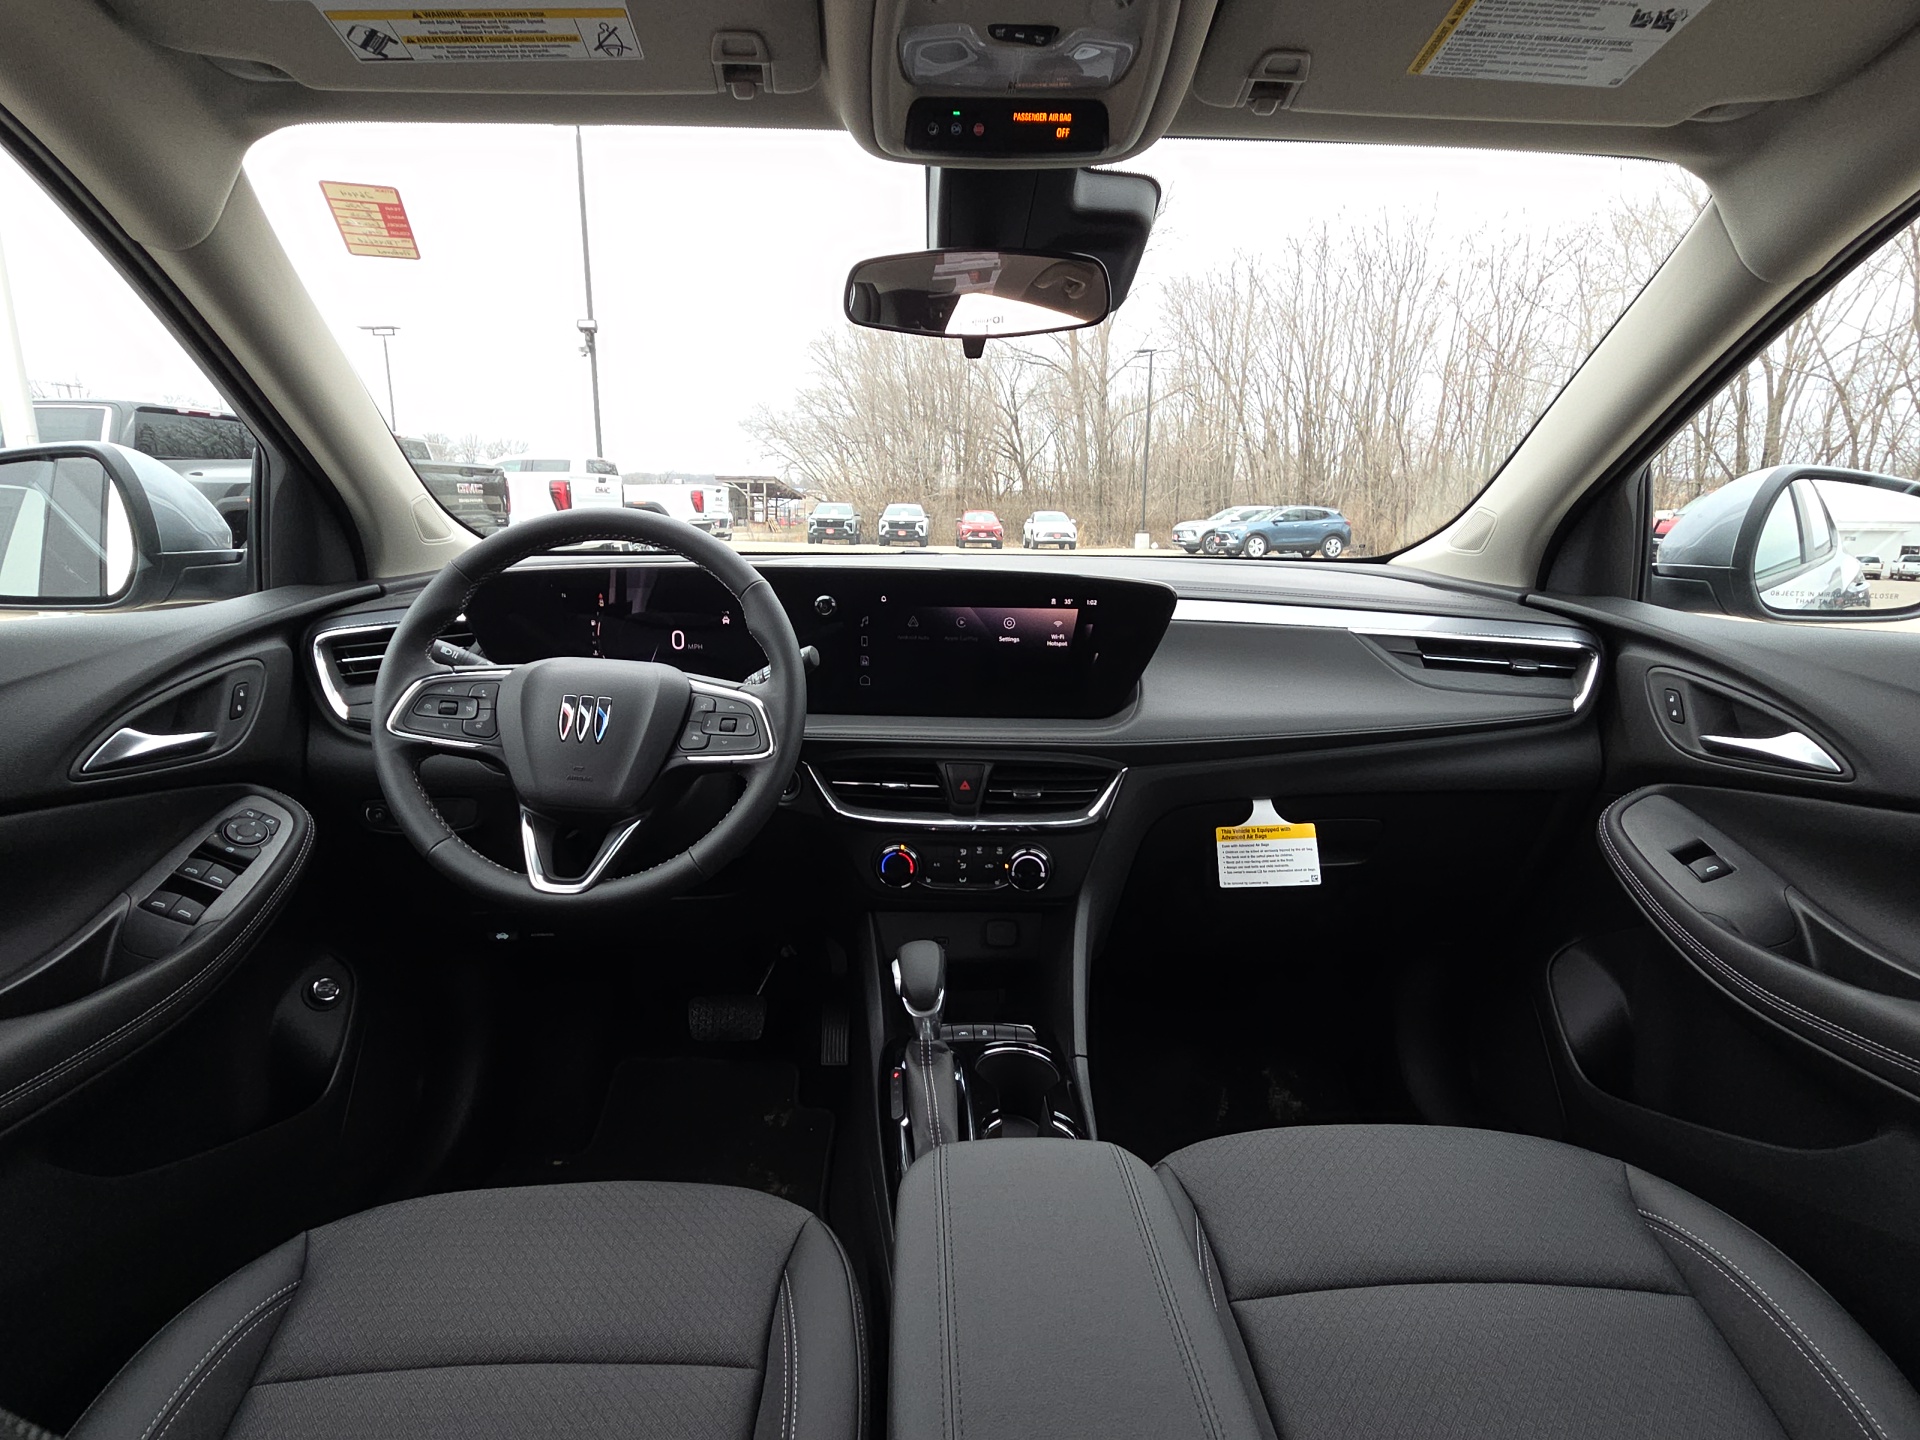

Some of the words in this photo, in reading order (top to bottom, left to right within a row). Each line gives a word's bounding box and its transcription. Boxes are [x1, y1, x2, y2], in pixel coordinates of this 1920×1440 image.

[422, 10, 467, 18] WARNING:
[1013, 112, 1047, 121] PASSENGER
[1048, 112, 1059, 121] AIR
[1059, 112, 1072, 121] BAG
[1056, 127, 1070, 138] OFF
[456, 483, 483, 494] GMC
[671, 630, 685, 650] 0
[998, 635, 1020, 643] Settings
